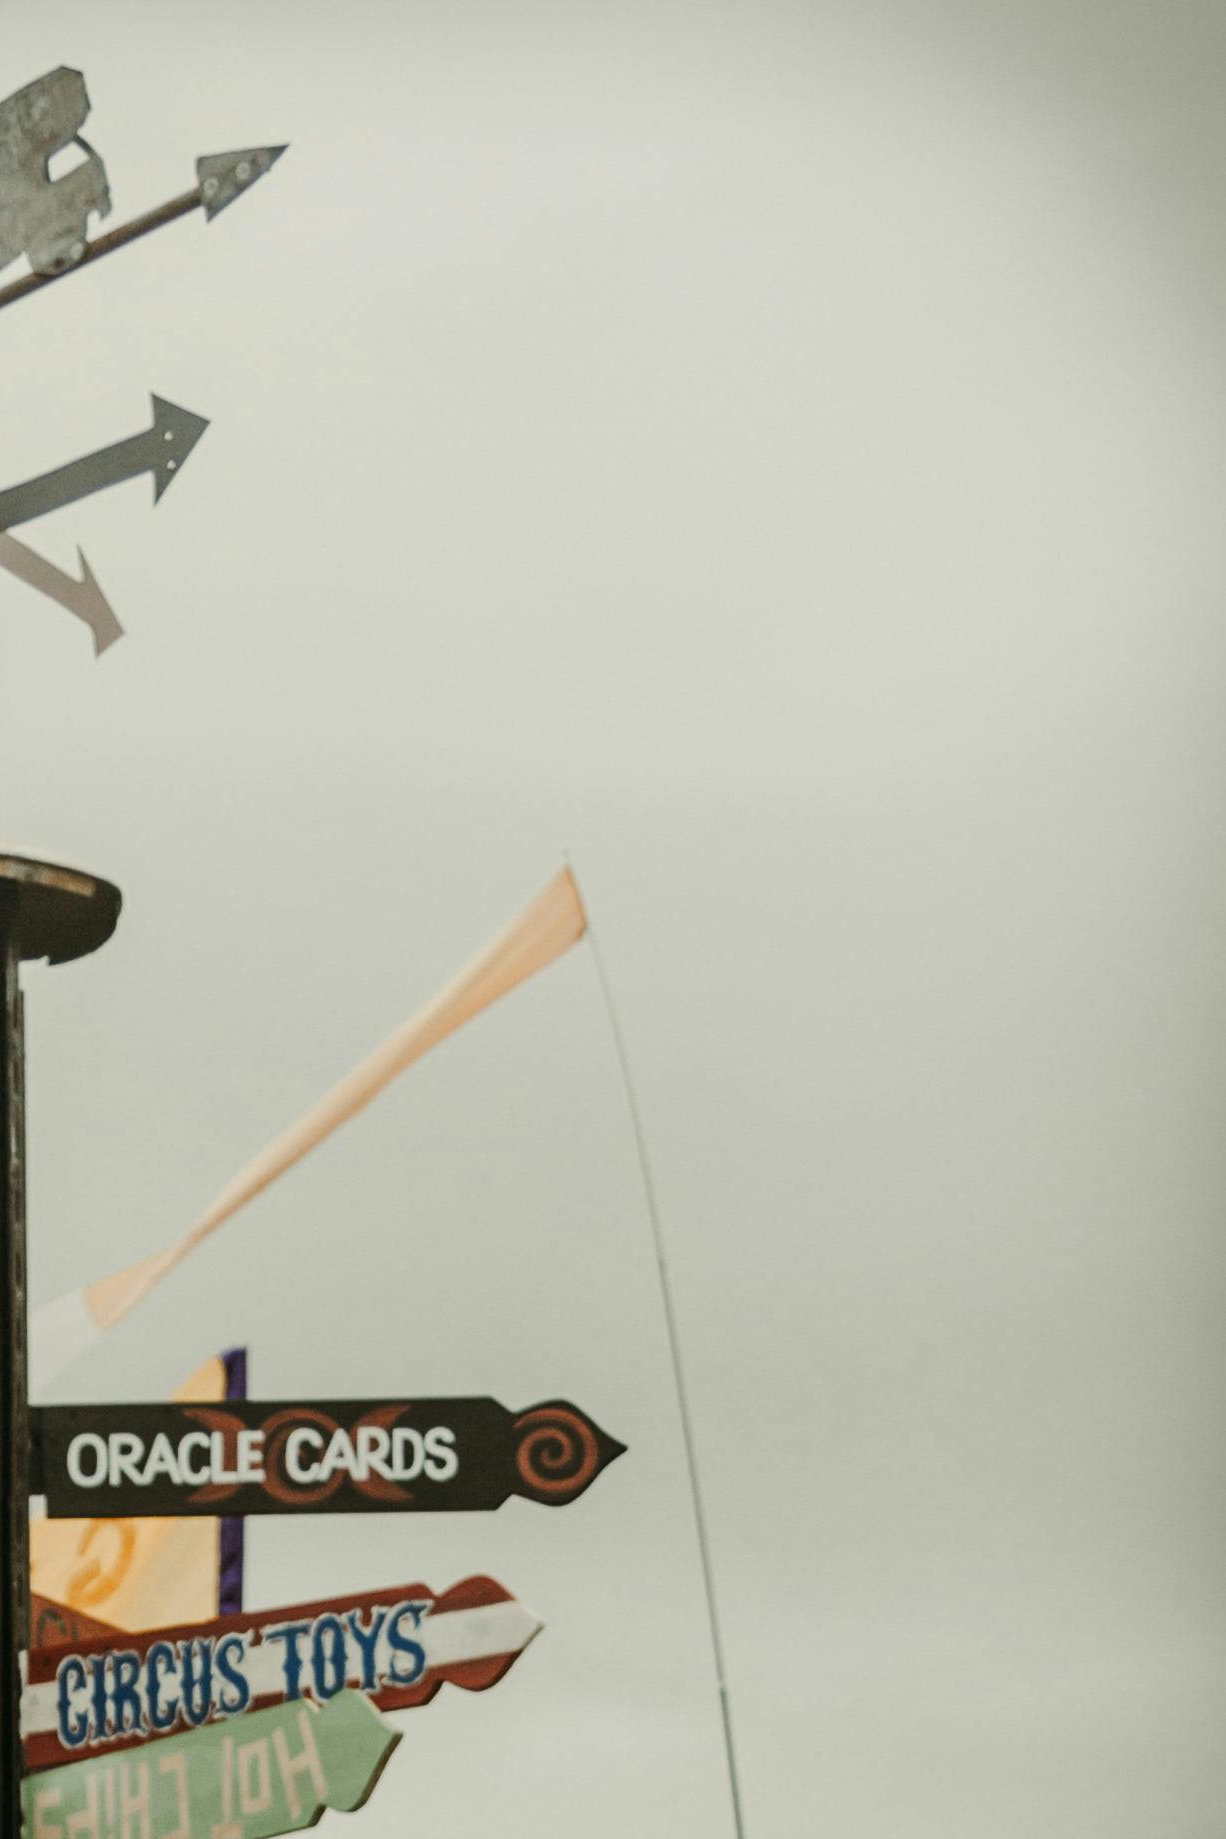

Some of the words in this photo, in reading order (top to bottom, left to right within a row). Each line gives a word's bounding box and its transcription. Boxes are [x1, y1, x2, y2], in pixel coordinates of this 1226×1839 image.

[66, 1430, 266, 1488] ORACLE
[284, 1426, 459, 1484] CARDS
[55, 1631, 253, 1750] CIRCUS
[262, 1599, 435, 1703] TOYS
